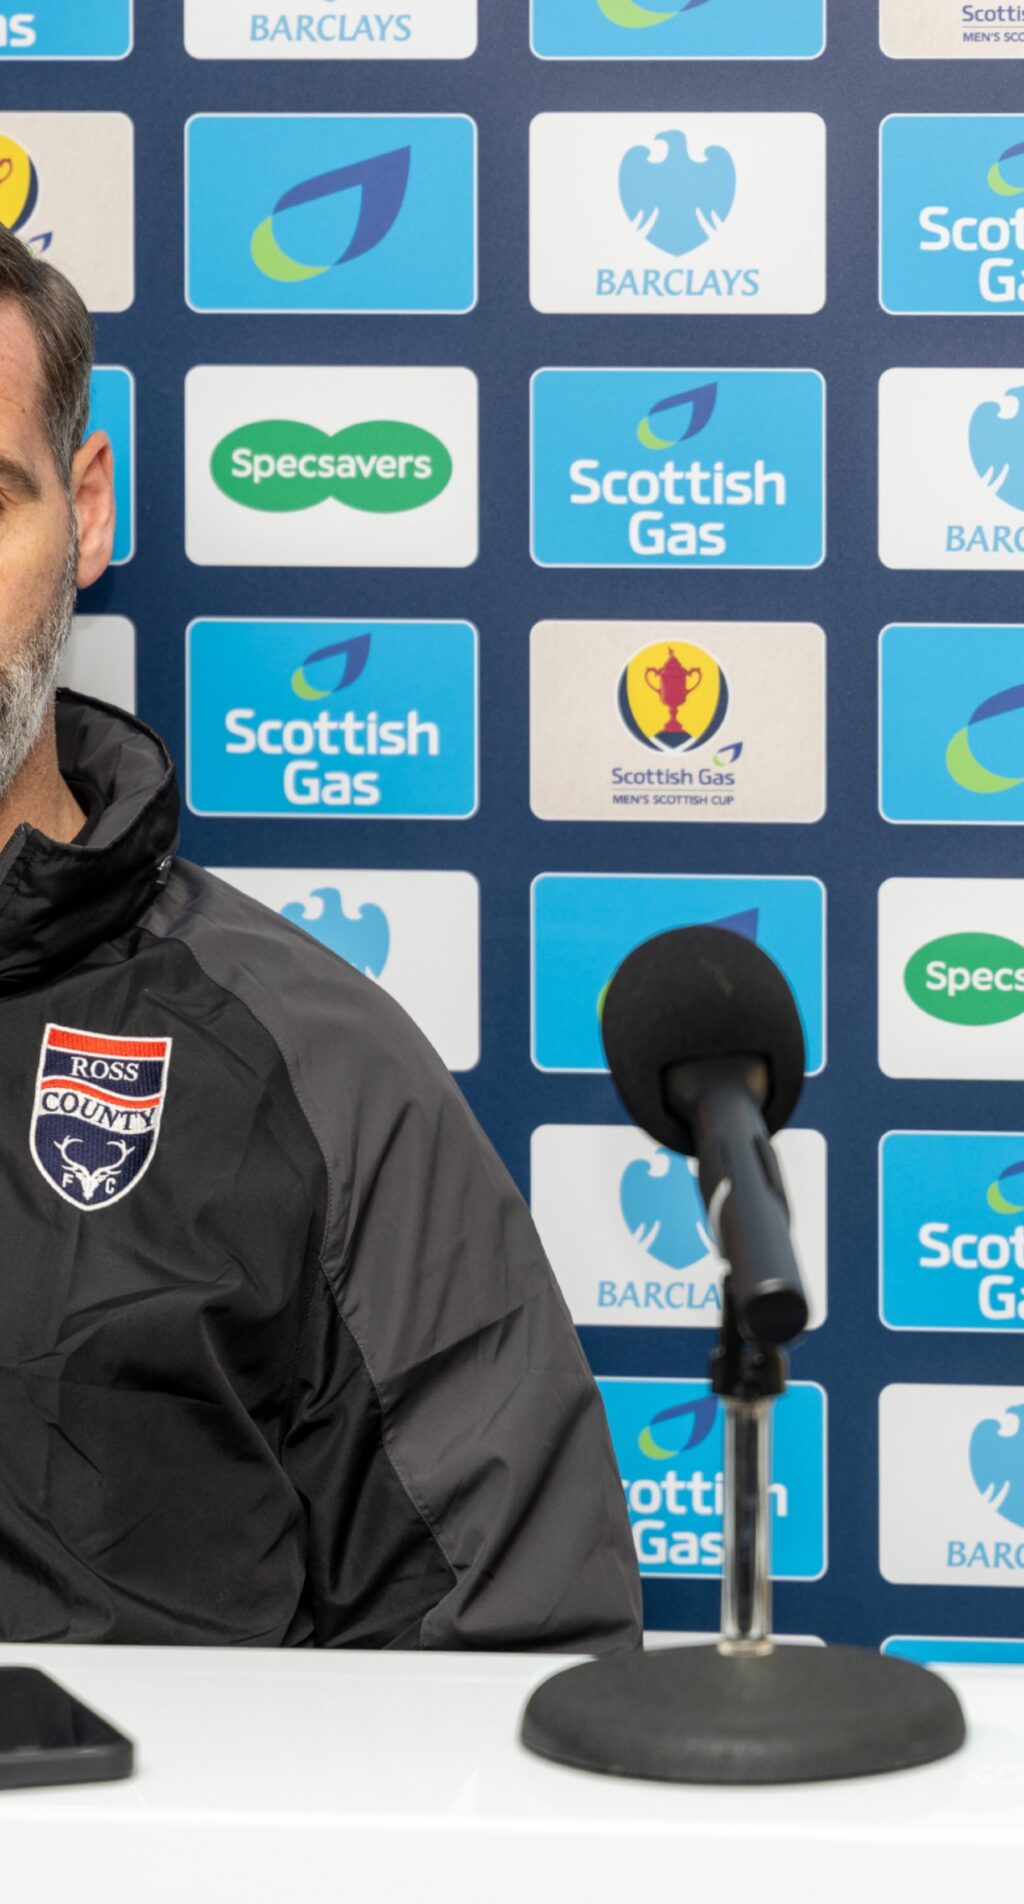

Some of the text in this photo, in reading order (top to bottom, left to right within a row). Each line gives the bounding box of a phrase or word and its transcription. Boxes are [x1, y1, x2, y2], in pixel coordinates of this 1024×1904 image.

[249, 14, 412, 43] BARCLAYS
[961, 5, 1024, 22] Scotti
[962, 32, 1000, 42] MEN'S
[595, 269, 760, 297] BARCLAYS
[230, 447, 433, 484] Specsavers
[569, 459, 787, 506] Scottish
[628, 510, 727, 556] Gas
[225, 709, 440, 757] Scottish
[284, 760, 381, 805] Gas
[611, 767, 735, 785] Scottish Gas
[612, 795, 734, 805] MEN'S SCOTTISH CUP
[70, 1056, 139, 1082] ROSS
[41, 1092, 157, 1131] COUNTY
[597, 1280, 724, 1311] BARCLA
[632, 1519, 725, 1566] Gas
